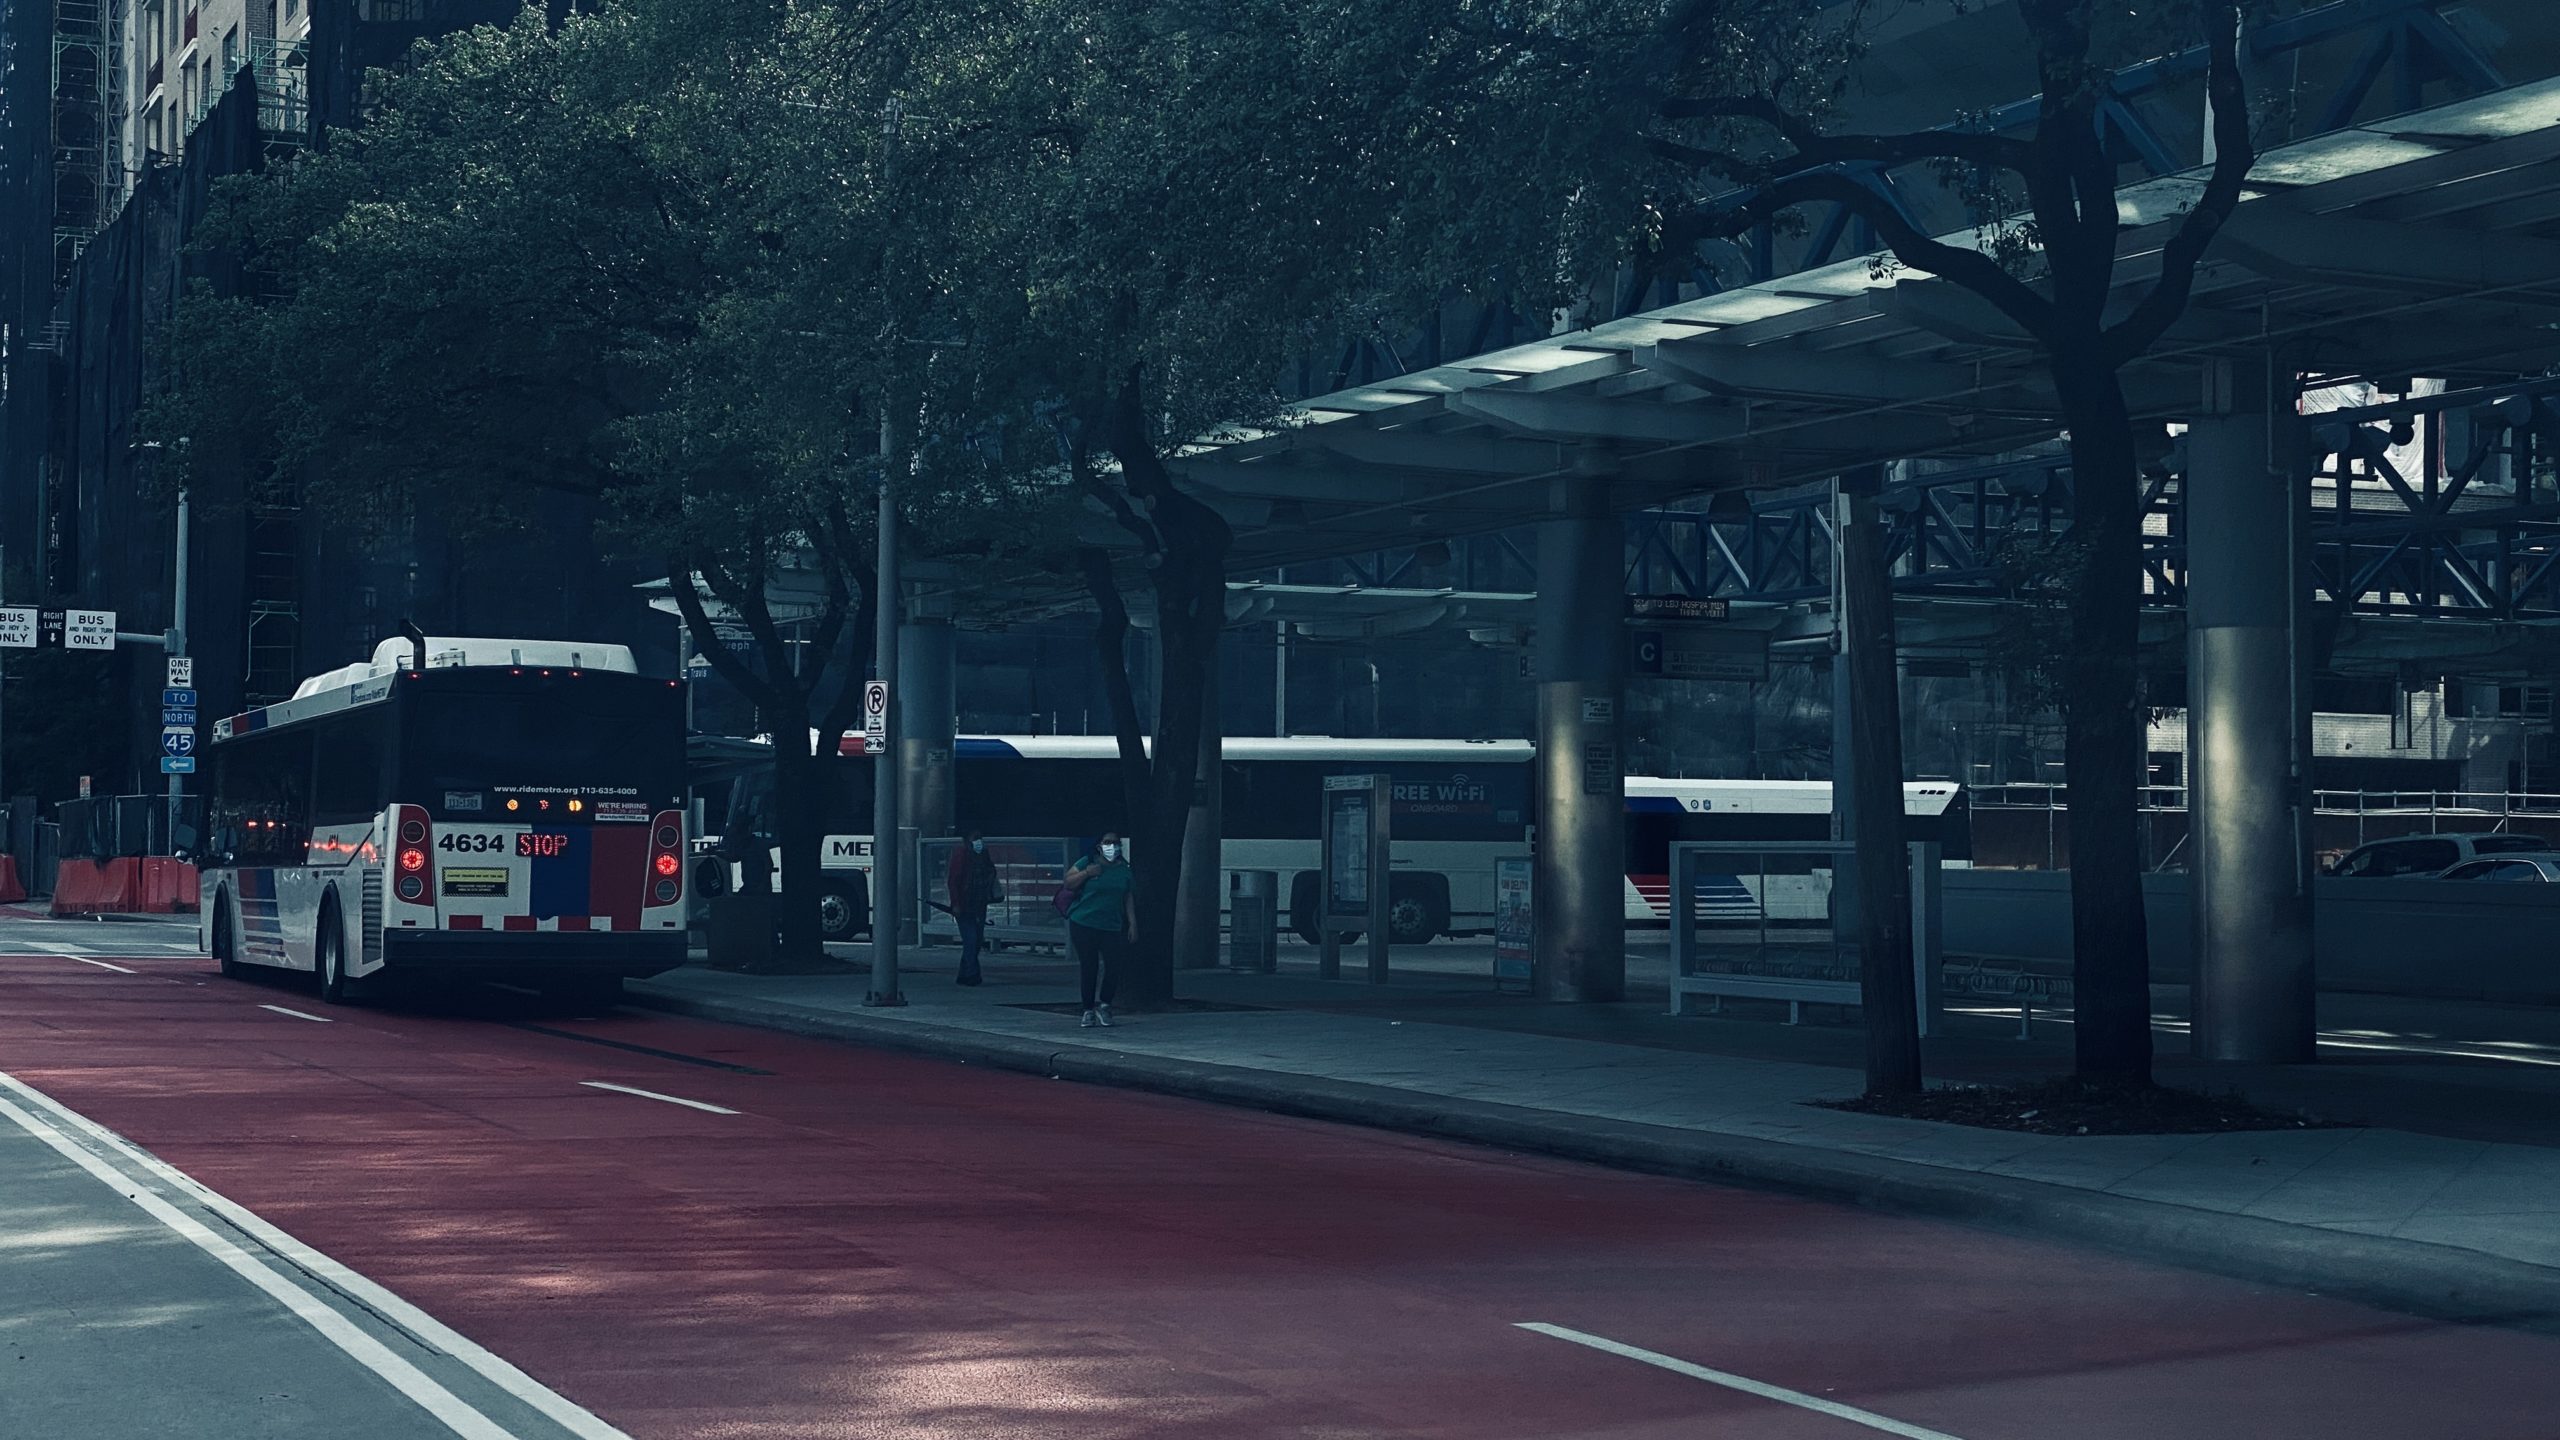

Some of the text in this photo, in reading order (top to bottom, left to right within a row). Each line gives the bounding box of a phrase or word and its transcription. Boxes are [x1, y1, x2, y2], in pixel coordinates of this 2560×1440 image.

[0, 613, 25, 622] BUS
[43, 611, 64, 620] RIGHT
[78, 615, 104, 625] BUS
[44, 621, 63, 630] LANE
[0, 633, 28, 643] NLY
[73, 634, 108, 645] ONLY
[1640, 642, 1655, 662] C
[170, 659, 190, 668] ONE
[170, 668, 190, 676] WAY
[172, 692, 188, 703] TO
[164, 713, 194, 723] NORTH
[166, 734, 191, 751] 45
[494, 784, 637, 795] www.ridemetro.org 713-635-4000
[672, 796, 680, 804] H
[597, 801, 647, 810] WE'RE HIRING
[438, 833, 505, 853] 4634
[519, 834, 567, 856] STOP
